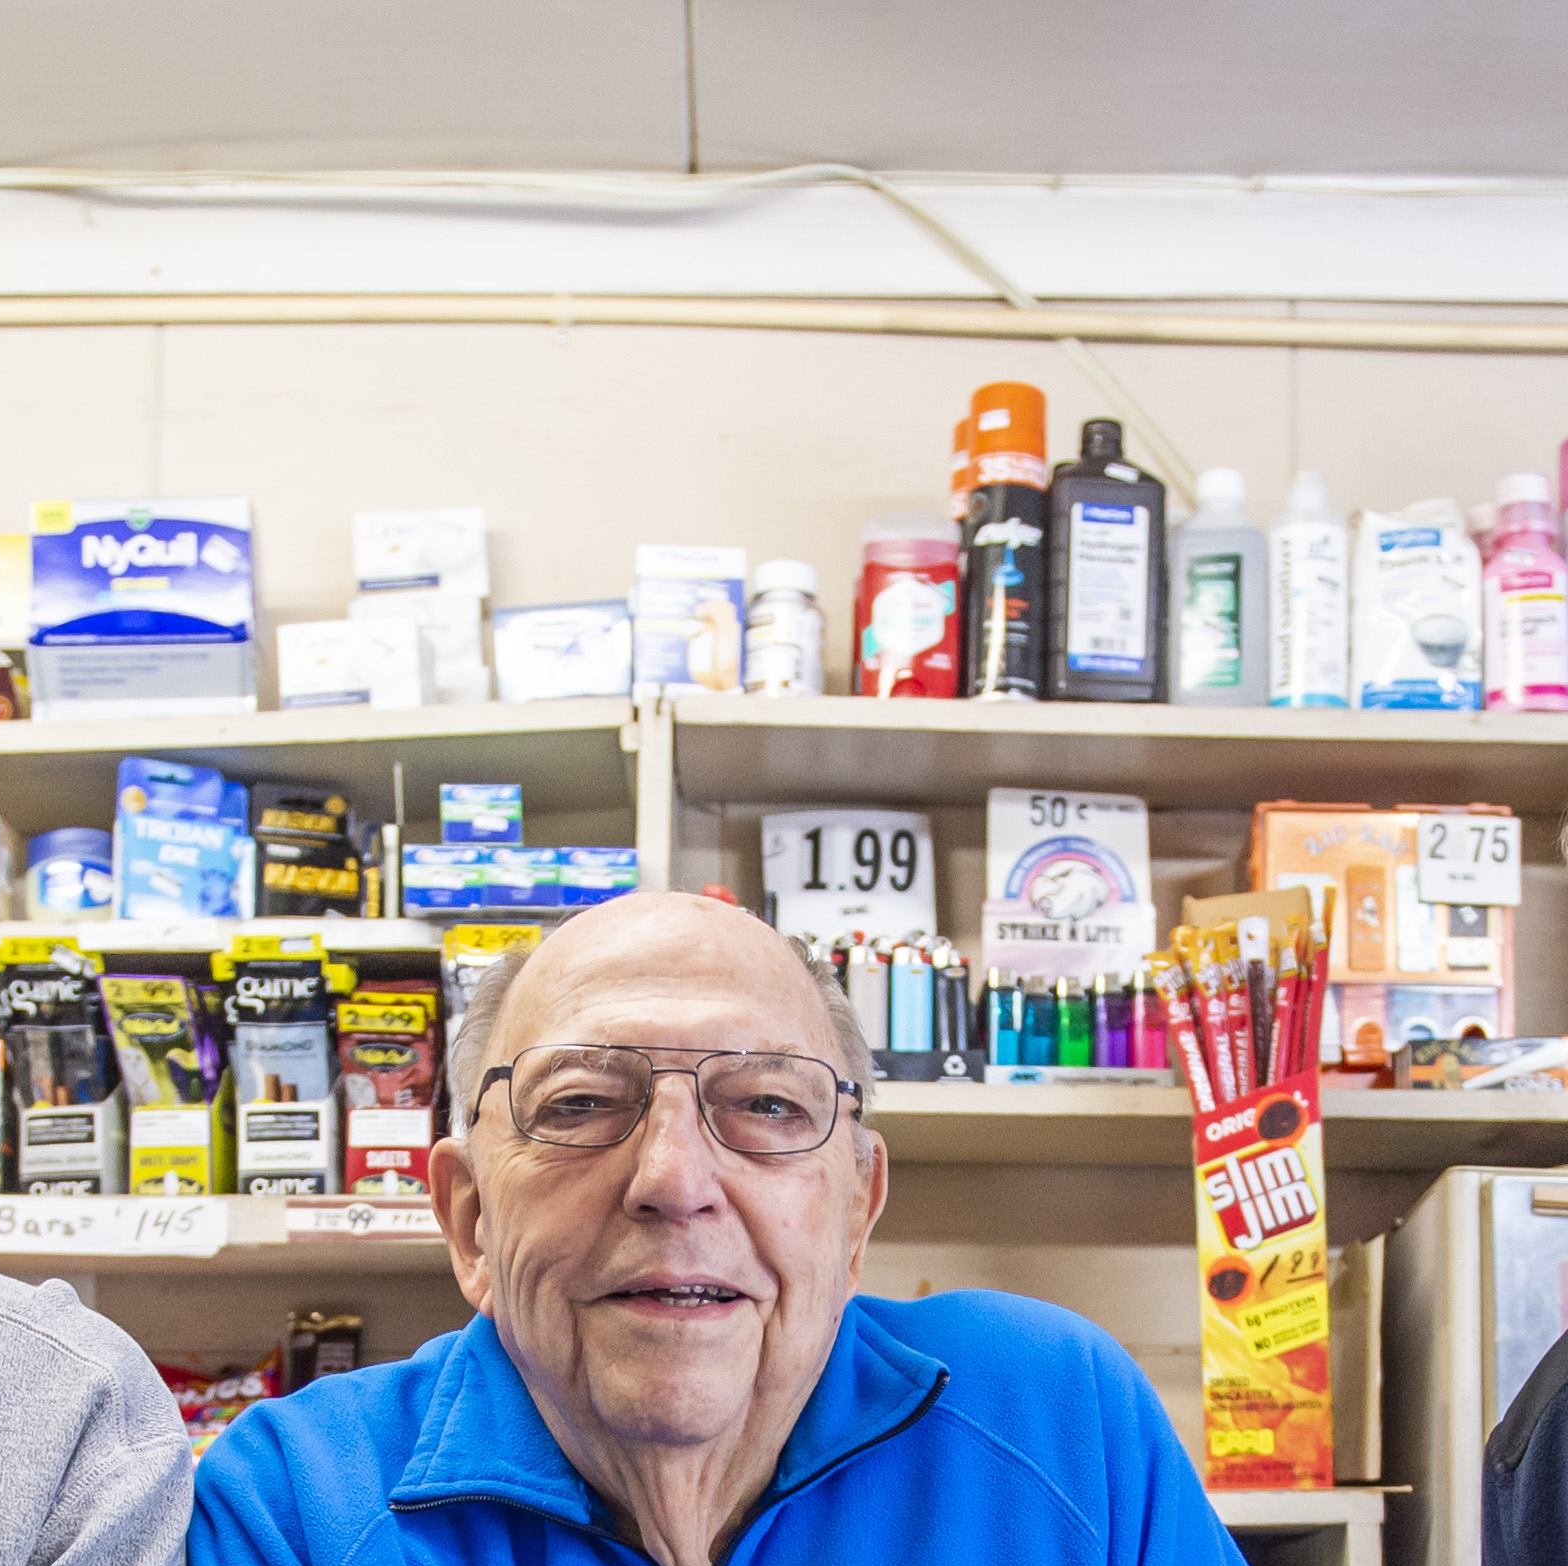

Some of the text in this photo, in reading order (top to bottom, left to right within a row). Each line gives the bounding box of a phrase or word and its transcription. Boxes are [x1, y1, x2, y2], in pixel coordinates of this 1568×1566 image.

[81, 531, 198, 576] NyQuil
[135, 814, 225, 849] TROJAN
[1302, 824, 1410, 858] ZIG-ZAG
[1429, 822, 1510, 863] 2 75
[998, 921, 1061, 941] STRIKE
[1083, 926, 1124, 944] LITE
[10, 978, 81, 1016] game
[236, 976, 319, 1014] game
[381, 1011, 416, 1029] 99
[1264, 1295, 1317, 1320] PROTEIN
[1254, 1335, 1272, 1353] NO
